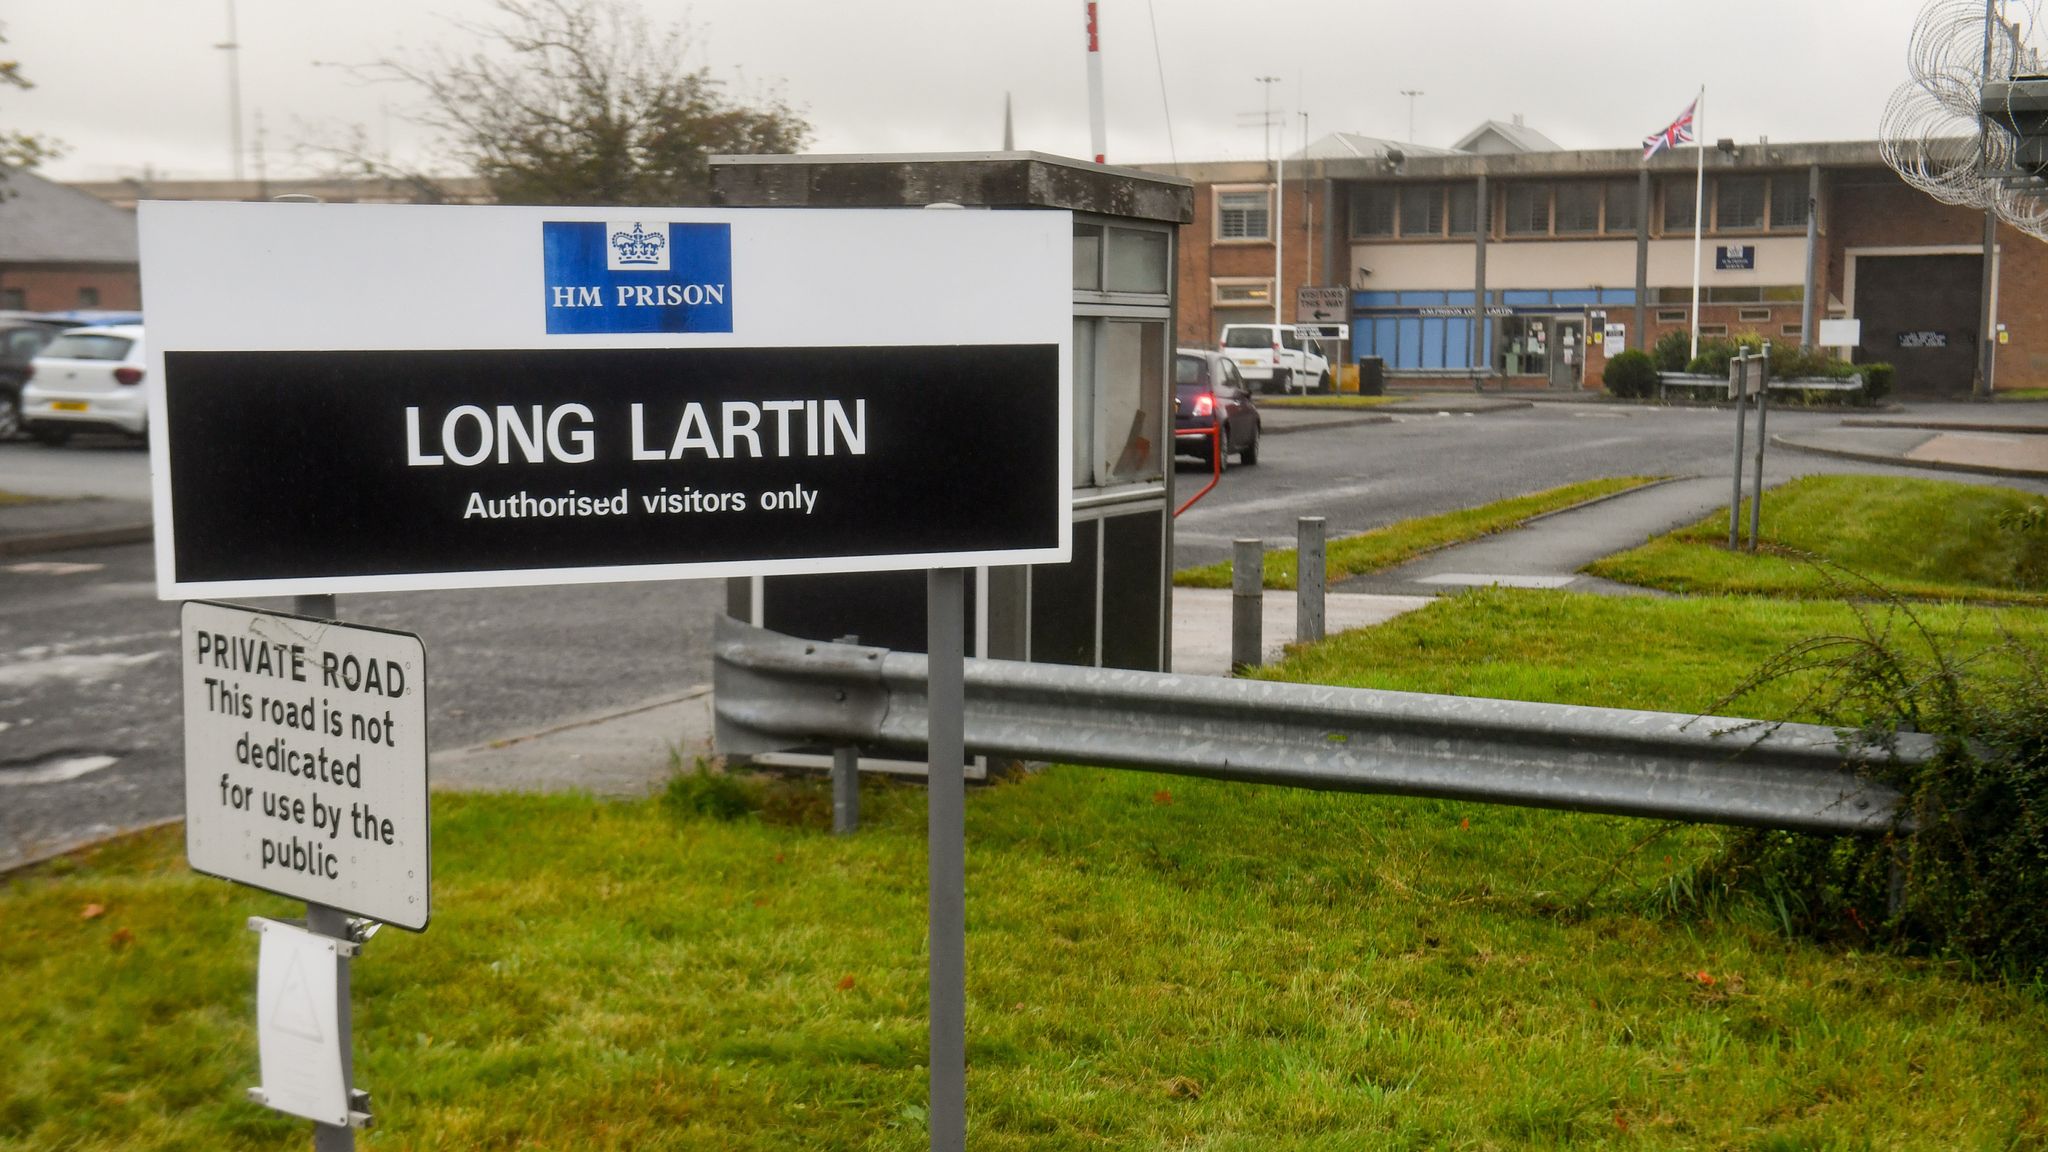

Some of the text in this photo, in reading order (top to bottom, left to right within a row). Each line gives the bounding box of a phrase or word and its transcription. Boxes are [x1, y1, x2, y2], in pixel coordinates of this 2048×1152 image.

[552, 284, 725, 307] HM PRISON
[405, 399, 866, 467] LONG LARTIN
[463, 483, 819, 520] Authorised visitors only
[197, 629, 405, 699] PRIVATE ROAD
[204, 677, 395, 748] This road is not
[235, 731, 362, 789] dedicated
[220, 772, 395, 846] for use by the
[261, 835, 339, 880] public
